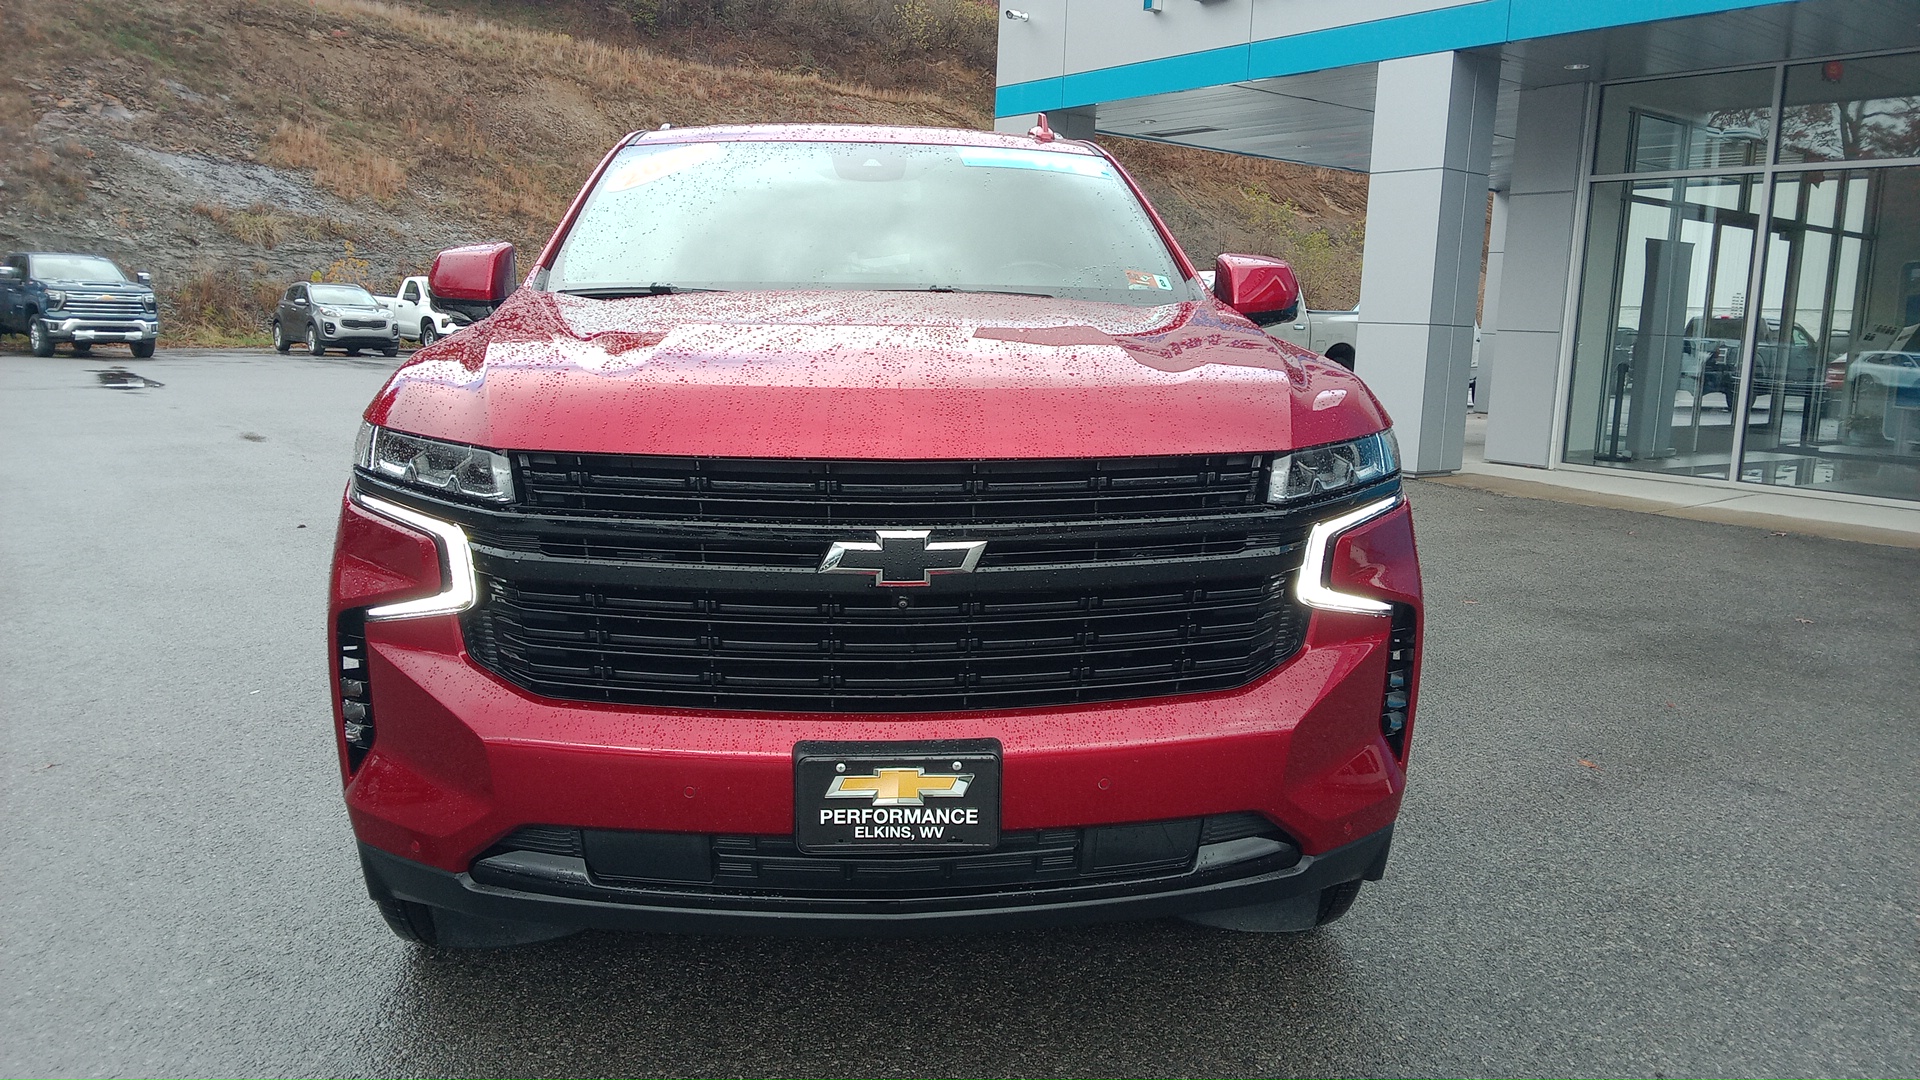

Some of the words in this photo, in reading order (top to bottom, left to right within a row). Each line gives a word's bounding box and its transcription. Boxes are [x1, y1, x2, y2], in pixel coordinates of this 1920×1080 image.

[820, 808, 979, 825] PERFORMANCE
[854, 826, 915, 840] ELKINS,
[919, 826, 945, 838] WV
